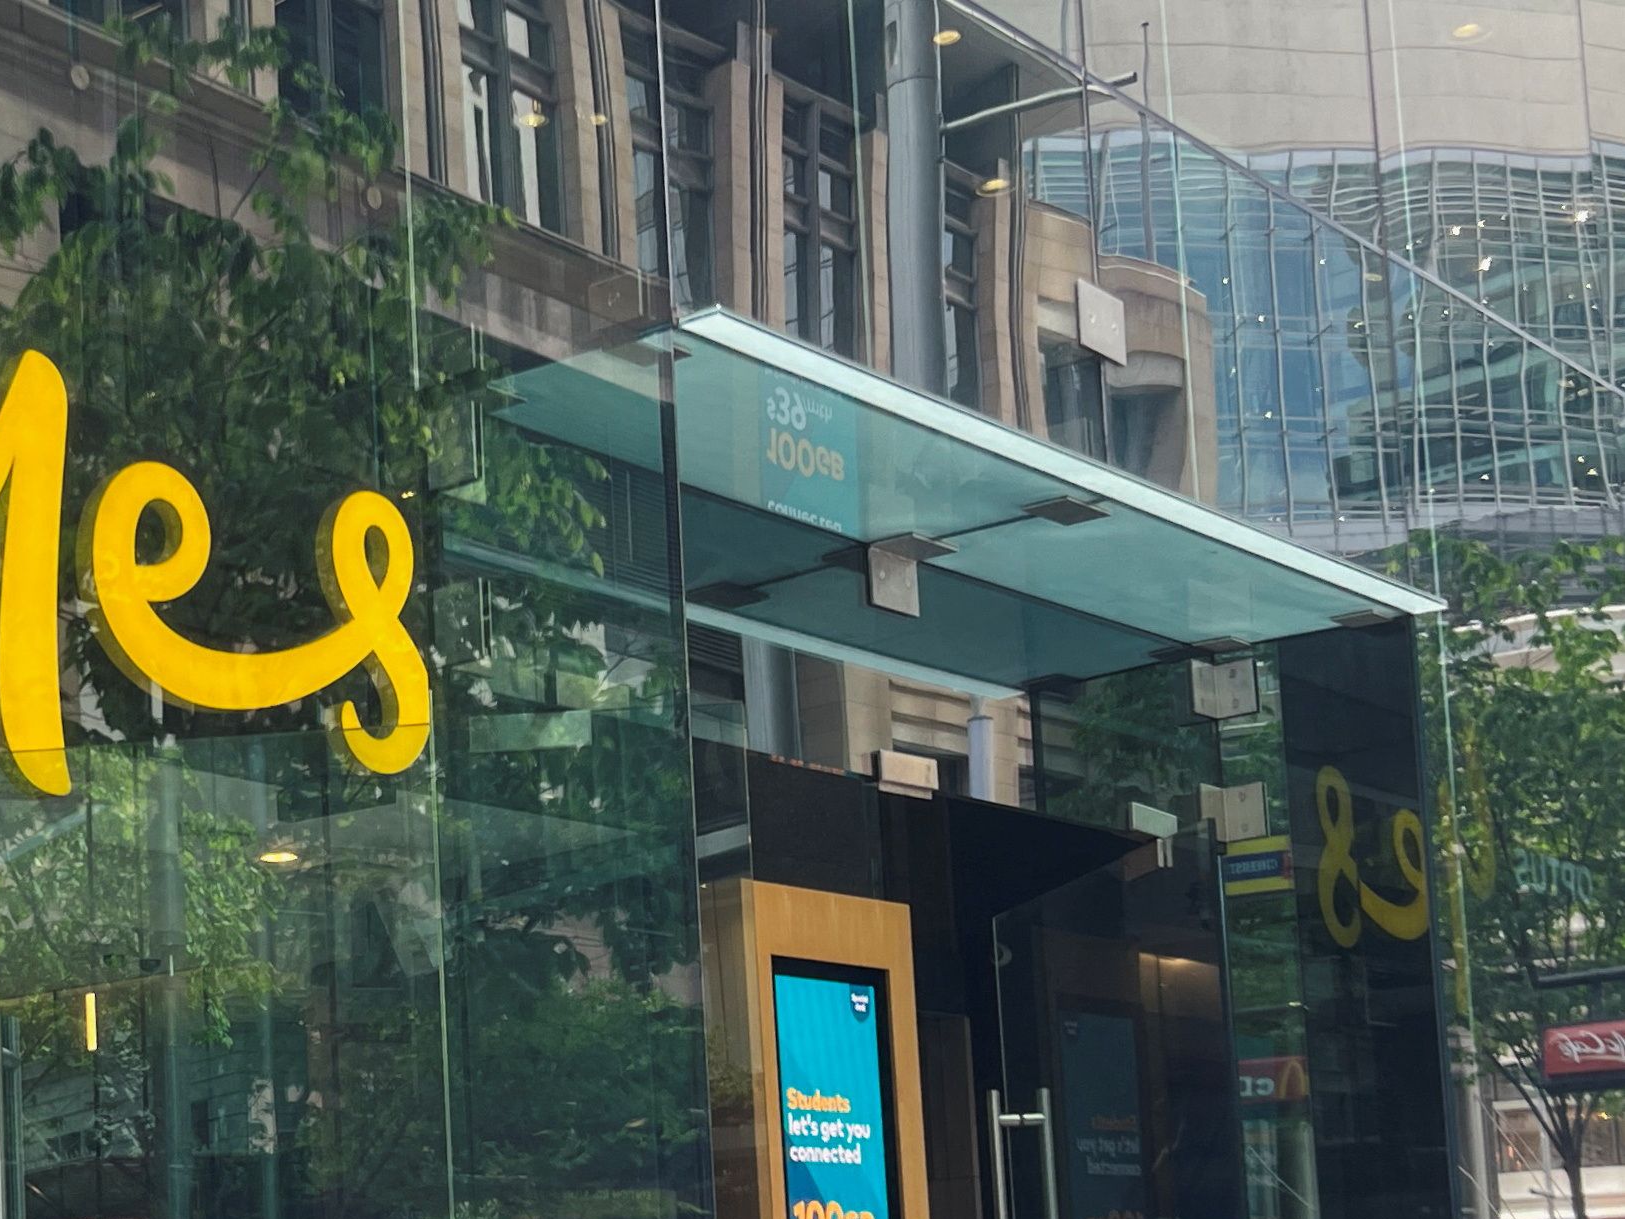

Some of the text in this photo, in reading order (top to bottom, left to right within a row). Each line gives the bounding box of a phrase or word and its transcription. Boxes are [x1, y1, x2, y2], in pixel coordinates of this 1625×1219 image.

[786, 1086, 851, 1113] Students
[820, 1118, 845, 1142] get
[846, 1122, 871, 1144] you
[789, 1142, 862, 1165] connected
